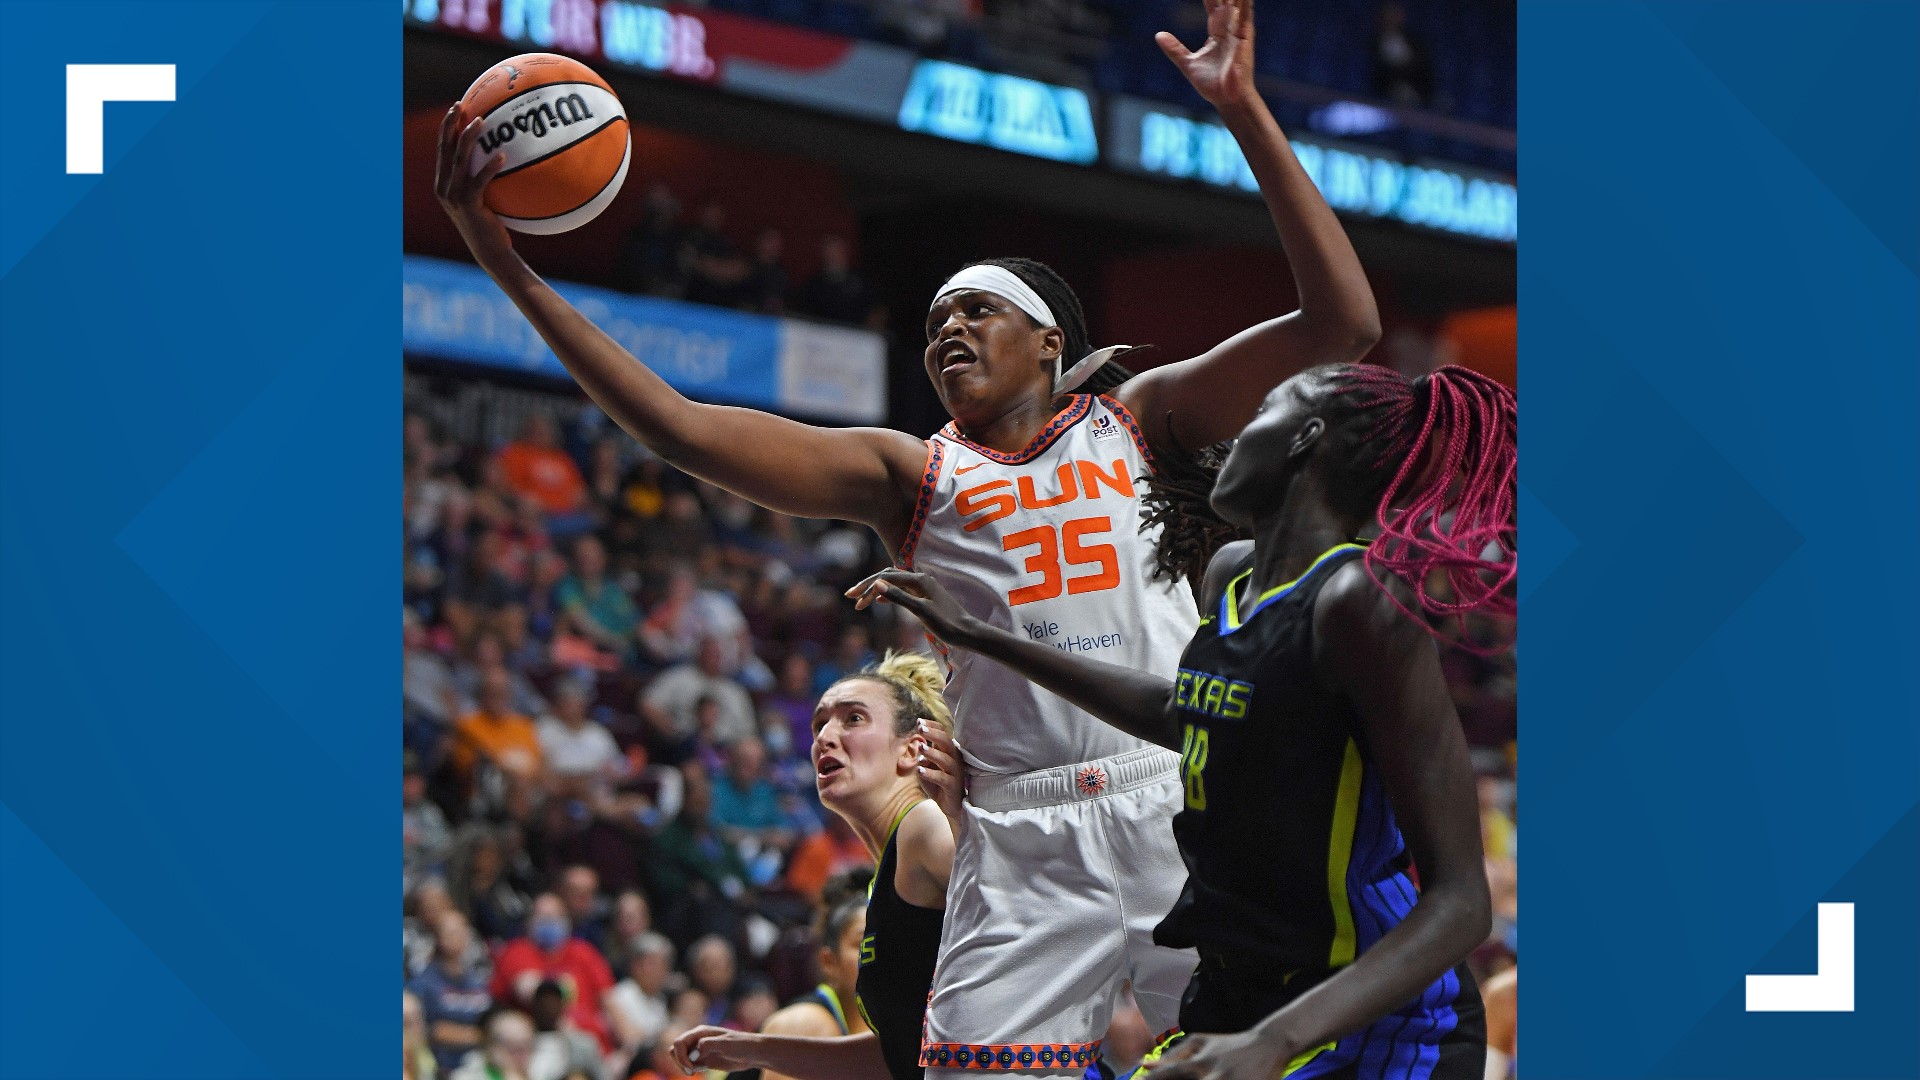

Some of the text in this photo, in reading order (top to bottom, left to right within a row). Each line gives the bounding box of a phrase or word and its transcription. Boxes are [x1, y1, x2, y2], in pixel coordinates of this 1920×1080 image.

[478, 93, 594, 154] Wilson
[955, 459, 1135, 532] SUN
[1003, 516, 1120, 606] 35
[1023, 620, 1060, 640] Yale
[1053, 632, 1122, 652] wHaven
[1176, 668, 1254, 719] EXAS
[1180, 723, 1209, 812] 8
